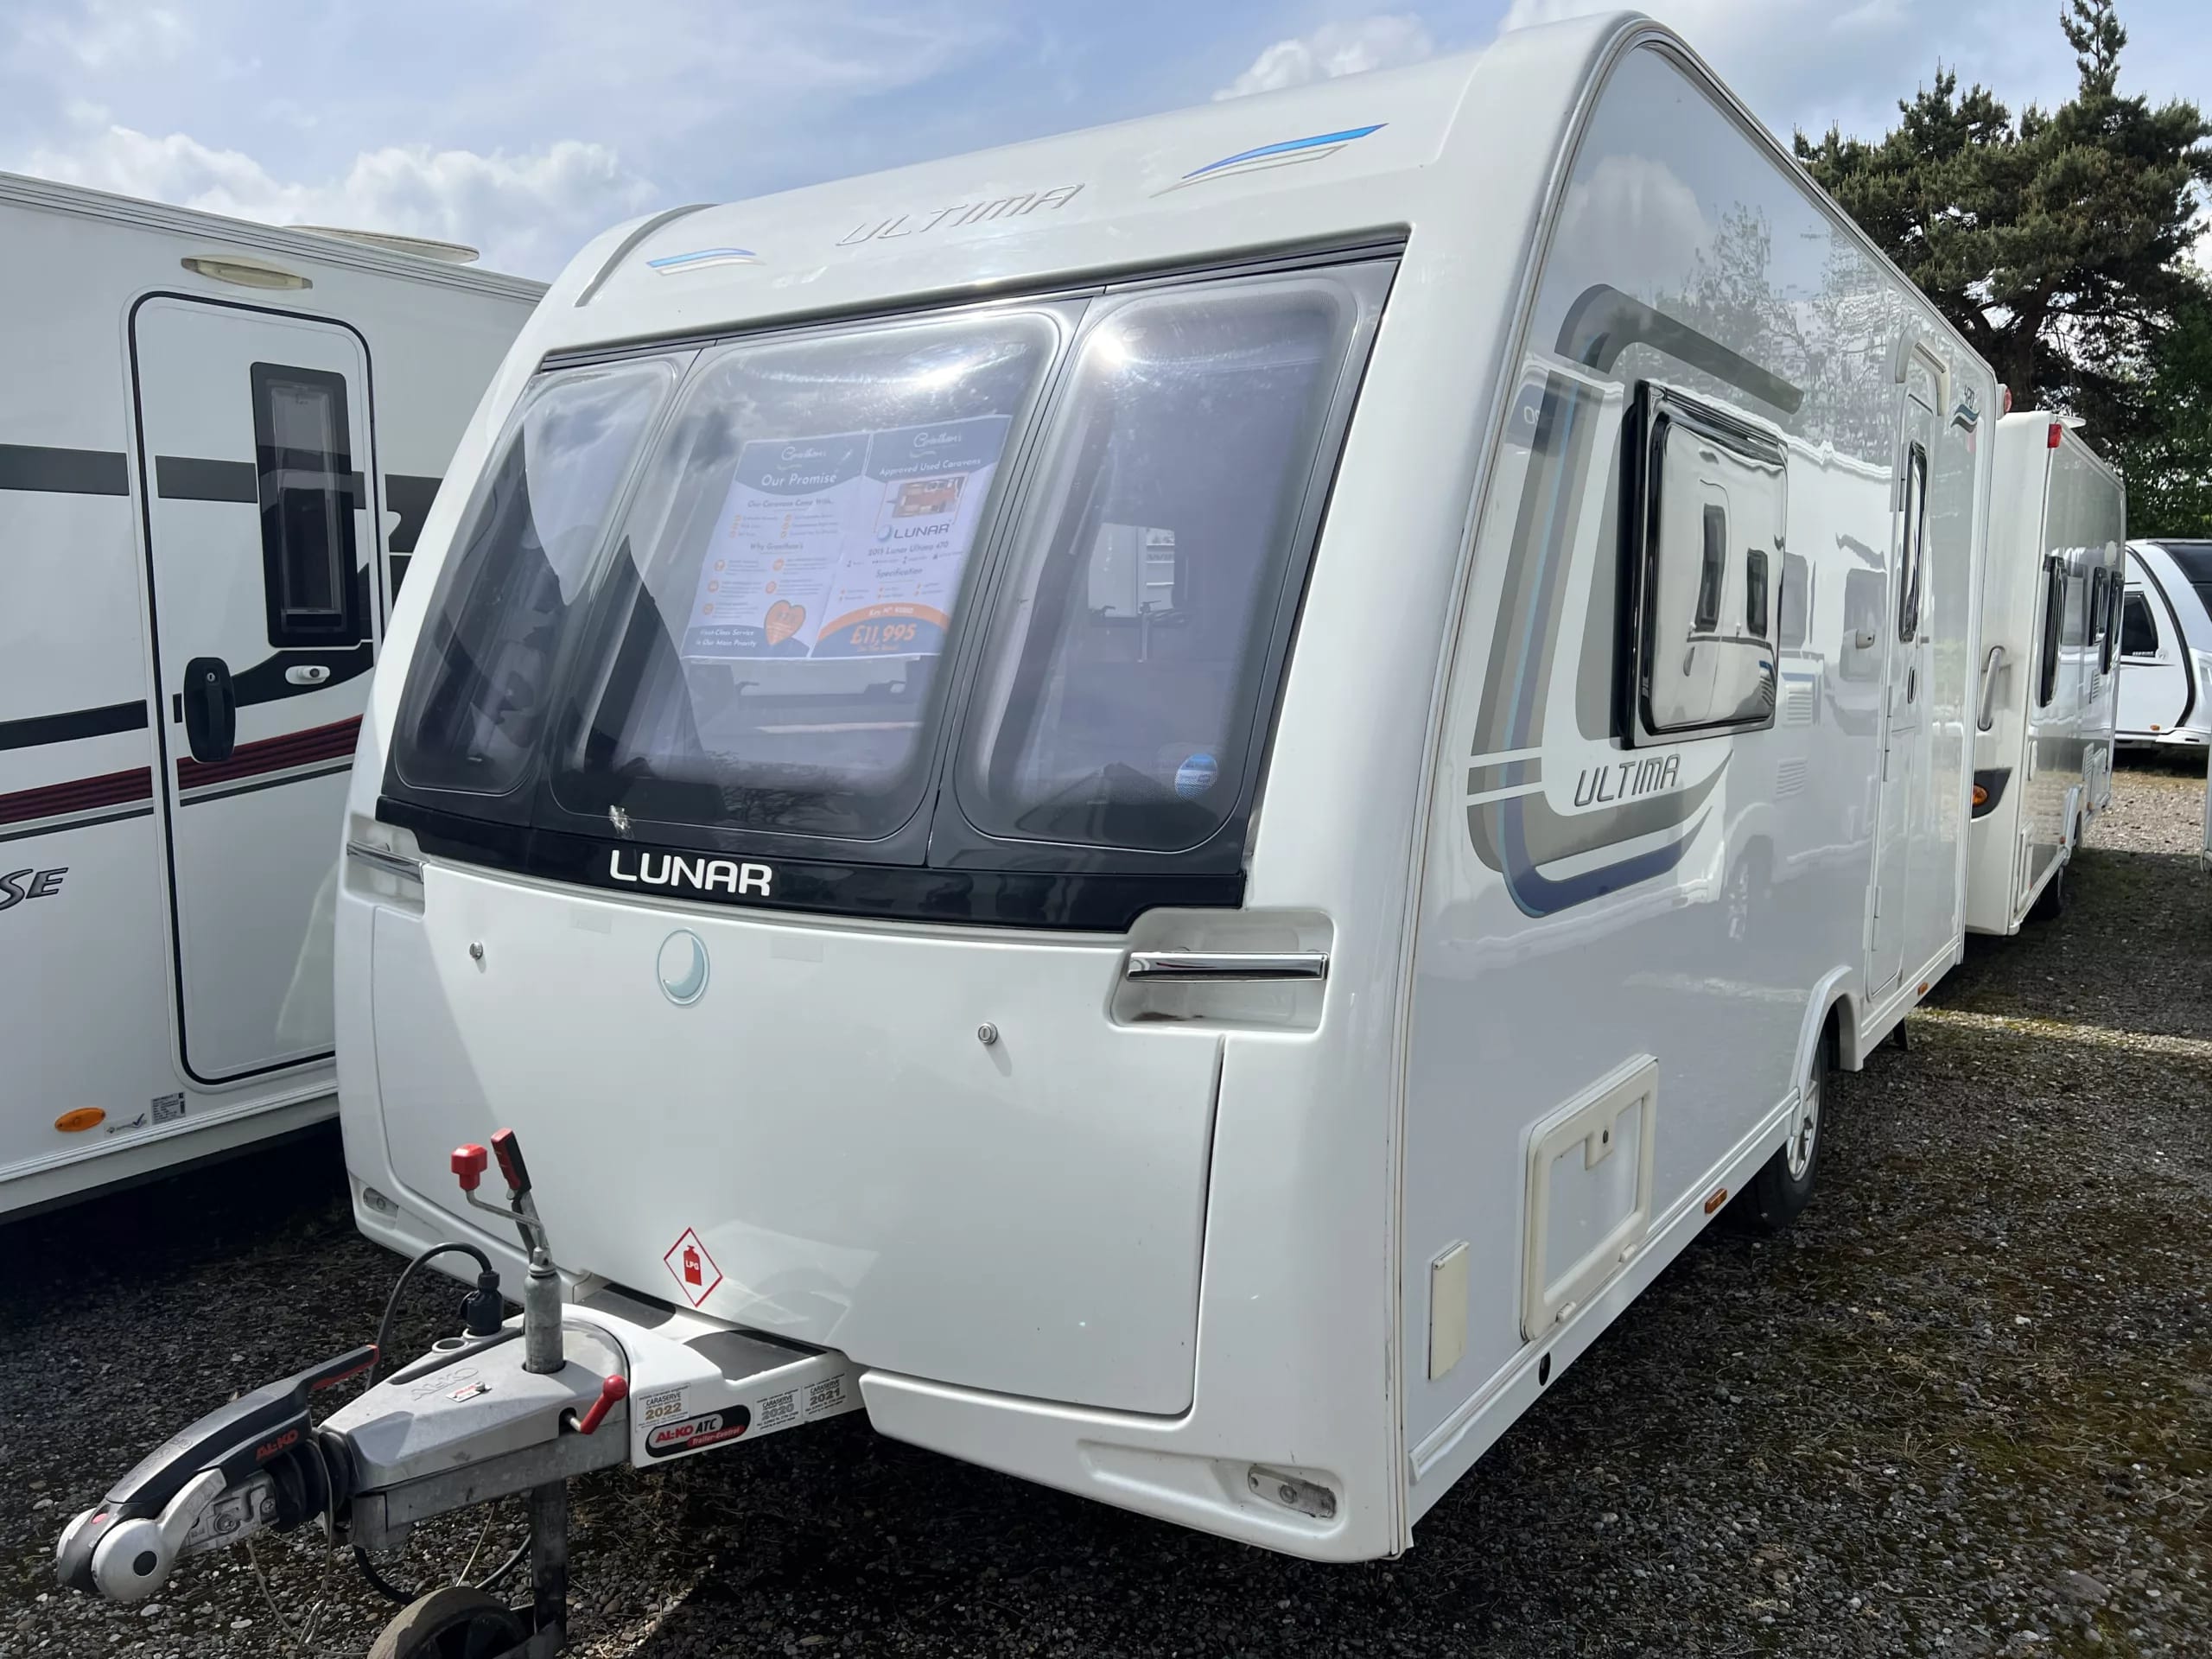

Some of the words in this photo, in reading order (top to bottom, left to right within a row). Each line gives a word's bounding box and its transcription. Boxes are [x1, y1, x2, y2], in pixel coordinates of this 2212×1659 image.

[836, 182, 1085, 246] ULTIMA
[879, 463, 918, 477] Approved
[920, 461, 941, 471] Used
[943, 458, 981, 469] Caravans
[761, 474, 785, 486] Our
[789, 473, 837, 486] Promise
[893, 524, 950, 539] LUNAR
[875, 568, 924, 579] Specification
[850, 622, 917, 646] £11,995
[1574, 753, 1681, 807] ULTIMA
[610, 849, 772, 896] LUNAR
[685, 1260, 700, 1271] LPG
[645, 1391, 682, 1406] CARASERVE
[810, 1387, 841, 1407] 2021
[645, 1402, 682, 1421] 2022
[761, 1403, 795, 1421] 2020
[655, 1425, 694, 1444] AL-KO
[696, 1418, 717, 1435] ATC
[255, 1428, 298, 1460] AL-KO
